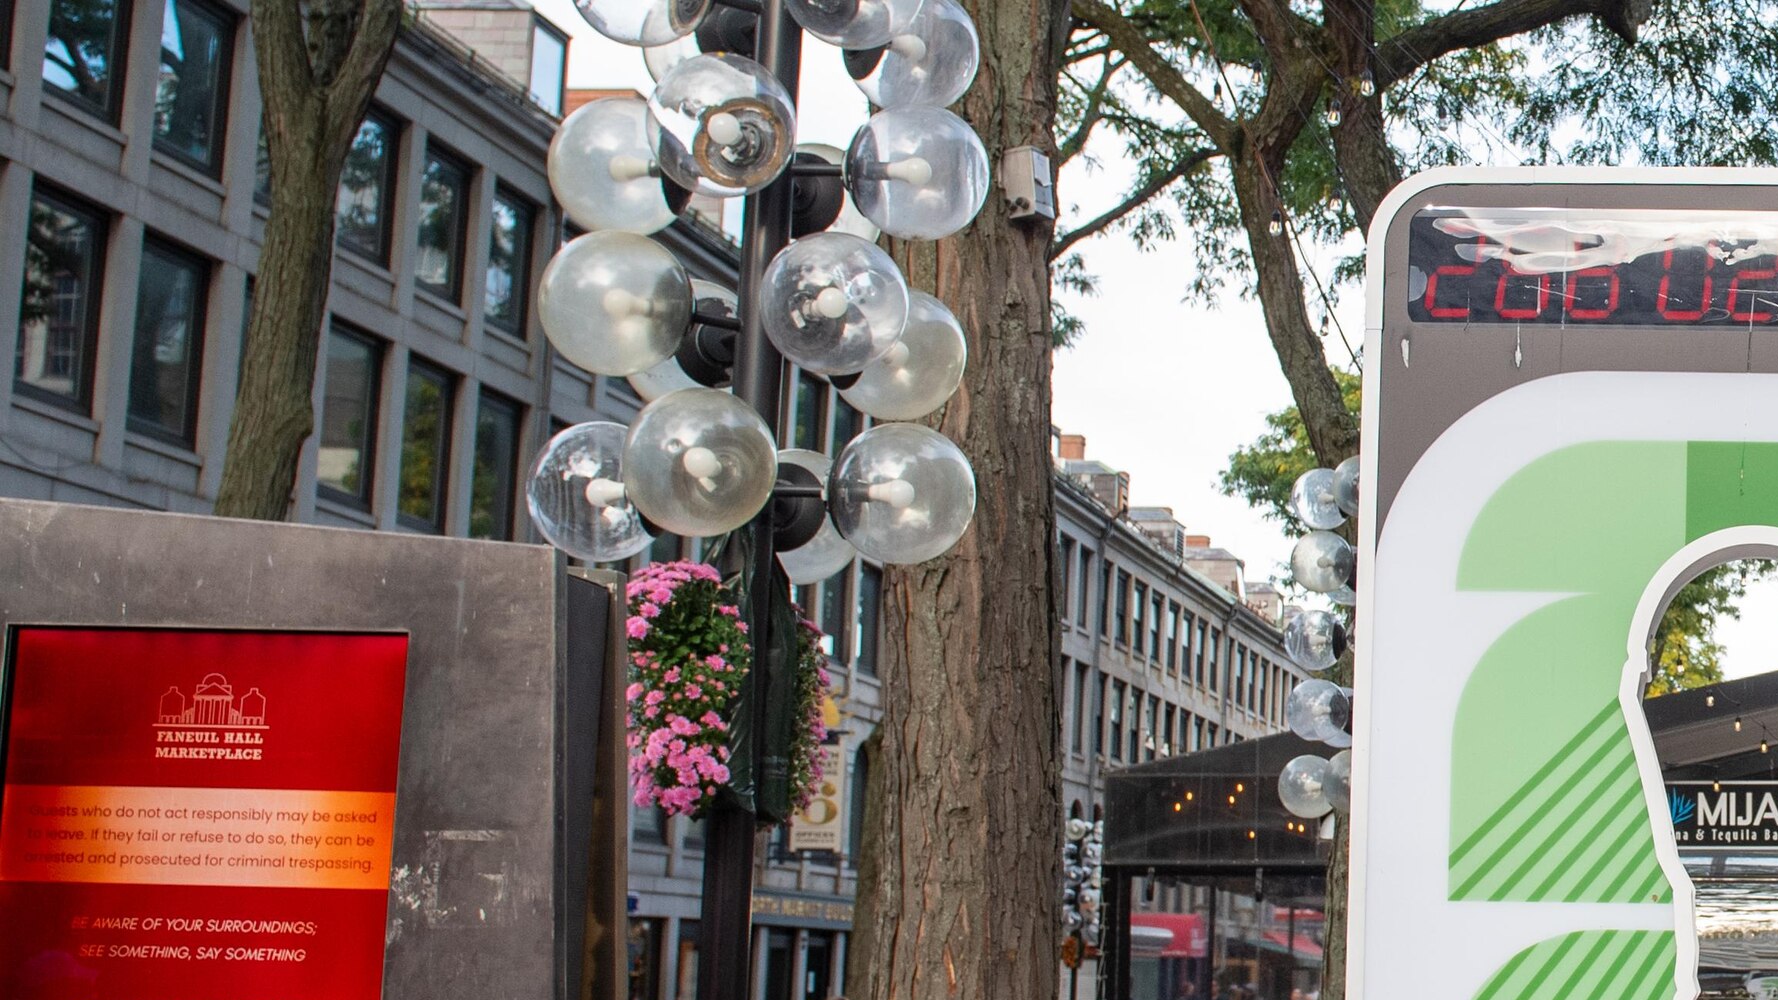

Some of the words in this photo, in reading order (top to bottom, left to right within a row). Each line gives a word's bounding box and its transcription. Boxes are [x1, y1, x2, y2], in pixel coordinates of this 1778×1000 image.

[157, 731, 219, 743] FANEUIL
[224, 732, 263, 744] HALL
[155, 746, 262, 760] MARKETPLACE
[82, 805, 112, 818] who
[115, 805, 135, 818] do
[137, 806, 162, 819] not
[165, 806, 188, 820] act
[191, 806, 272, 824] responsibly
[276, 810, 308, 826] may
[312, 809, 331, 823] be
[334, 810, 377, 824] asked
[91, 828, 99, 840] If
[102, 828, 135, 845] they
[137, 828, 159, 842] fail
[161, 831, 177, 842] or
[179, 829, 224, 844] refuse
[227, 831, 242, 845] to
[244, 830, 265, 845] do
[267, 833, 288, 848] so,
[290, 831, 322, 848] they
[325, 834, 353, 847] can
[356, 832, 375, 847] be
[1696, 829, 1704, 841] &
[1712, 828, 1757, 842] Tequila
[87, 852, 116, 866] and
[120, 852, 201, 868] prosecuted
[204, 853, 224, 867] for
[227, 854, 285, 869] criminal
[288, 856, 374, 874] trespassing.
[72, 916, 87, 929] BE
[92, 917, 138, 931] AWARE
[142, 917, 162, 931] OF
[166, 918, 204, 932] YOUR
[206, 919, 318, 936] SURROUNDINGS;
[79, 945, 105, 958] SEE
[108, 945, 191, 961] SOMETHING,
[196, 946, 222, 960] SAY
[225, 947, 306, 962] SOMETHING
